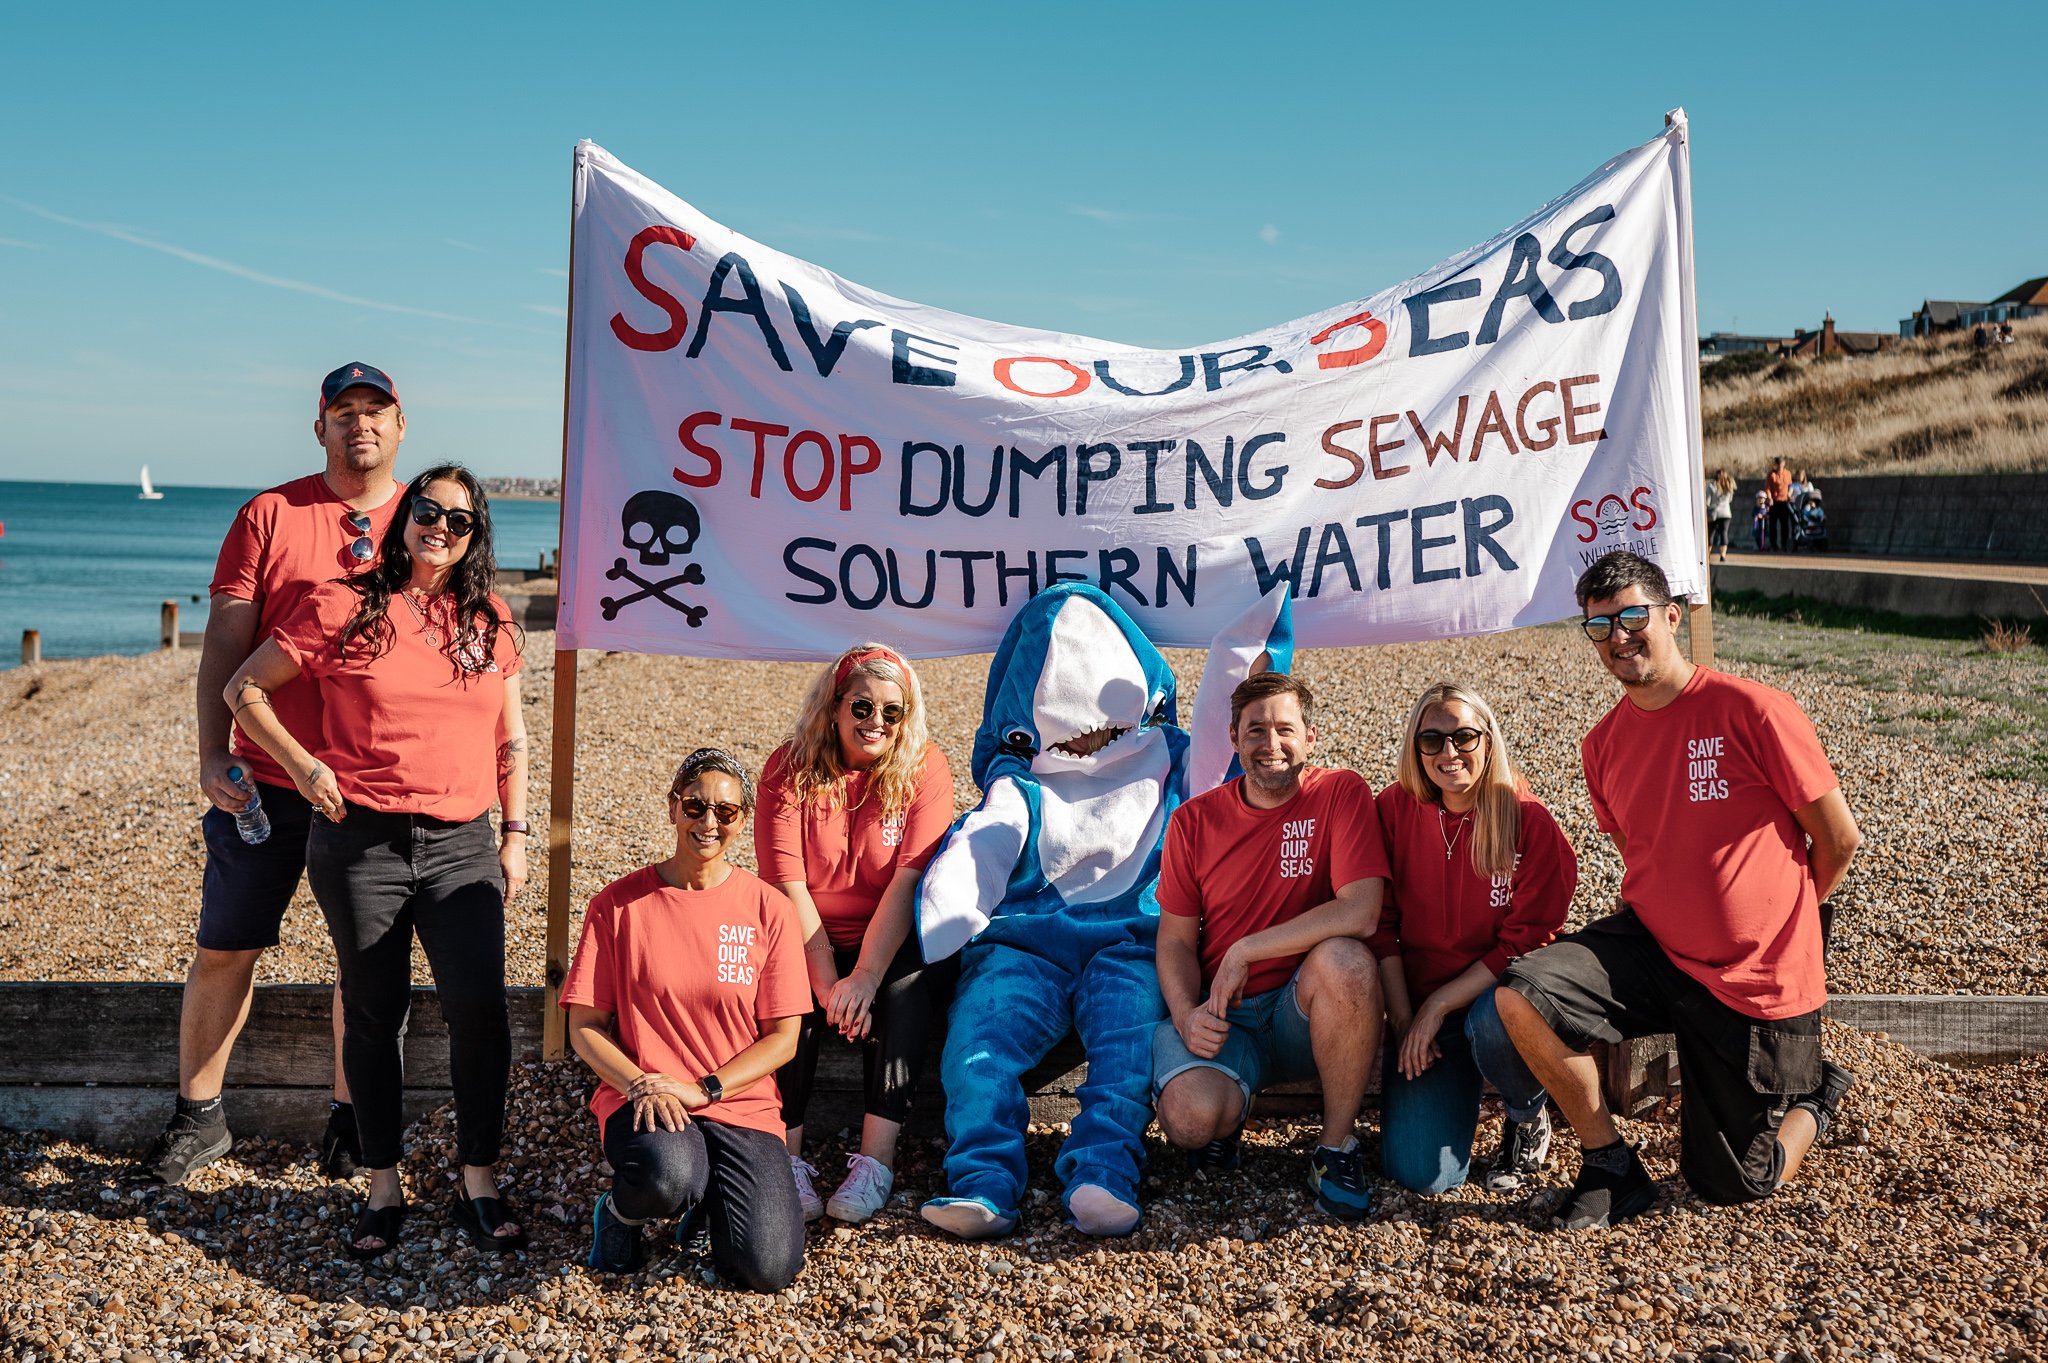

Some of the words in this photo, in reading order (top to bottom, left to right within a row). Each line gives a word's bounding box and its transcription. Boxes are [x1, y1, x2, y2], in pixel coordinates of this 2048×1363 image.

[609, 225, 960, 387] SAVE
[993, 344, 1294, 398] OUR
[1310, 203, 1623, 370] SEAS
[673, 411, 881, 511] STOP
[899, 432, 1289, 518] DUMPING
[1313, 374, 1608, 489] SEWAGE
[1570, 486, 1657, 543] SOS
[783, 537, 1197, 609] SOUTHERN
[1244, 494, 1519, 600] WATER
[1687, 736, 1725, 760] SAVE
[1688, 759, 1719, 781] OUR
[1689, 779, 1729, 802] SEAS
[882, 828, 904, 847] SEA
[1282, 818, 1316, 840] SAVE
[1280, 839, 1309, 859] OUR
[1280, 857, 1314, 878] SEAS
[1489, 888, 1514, 908] SEA
[718, 924, 756, 947] SAVE
[717, 943, 749, 965] OUR
[717, 963, 754, 986] SEAS
